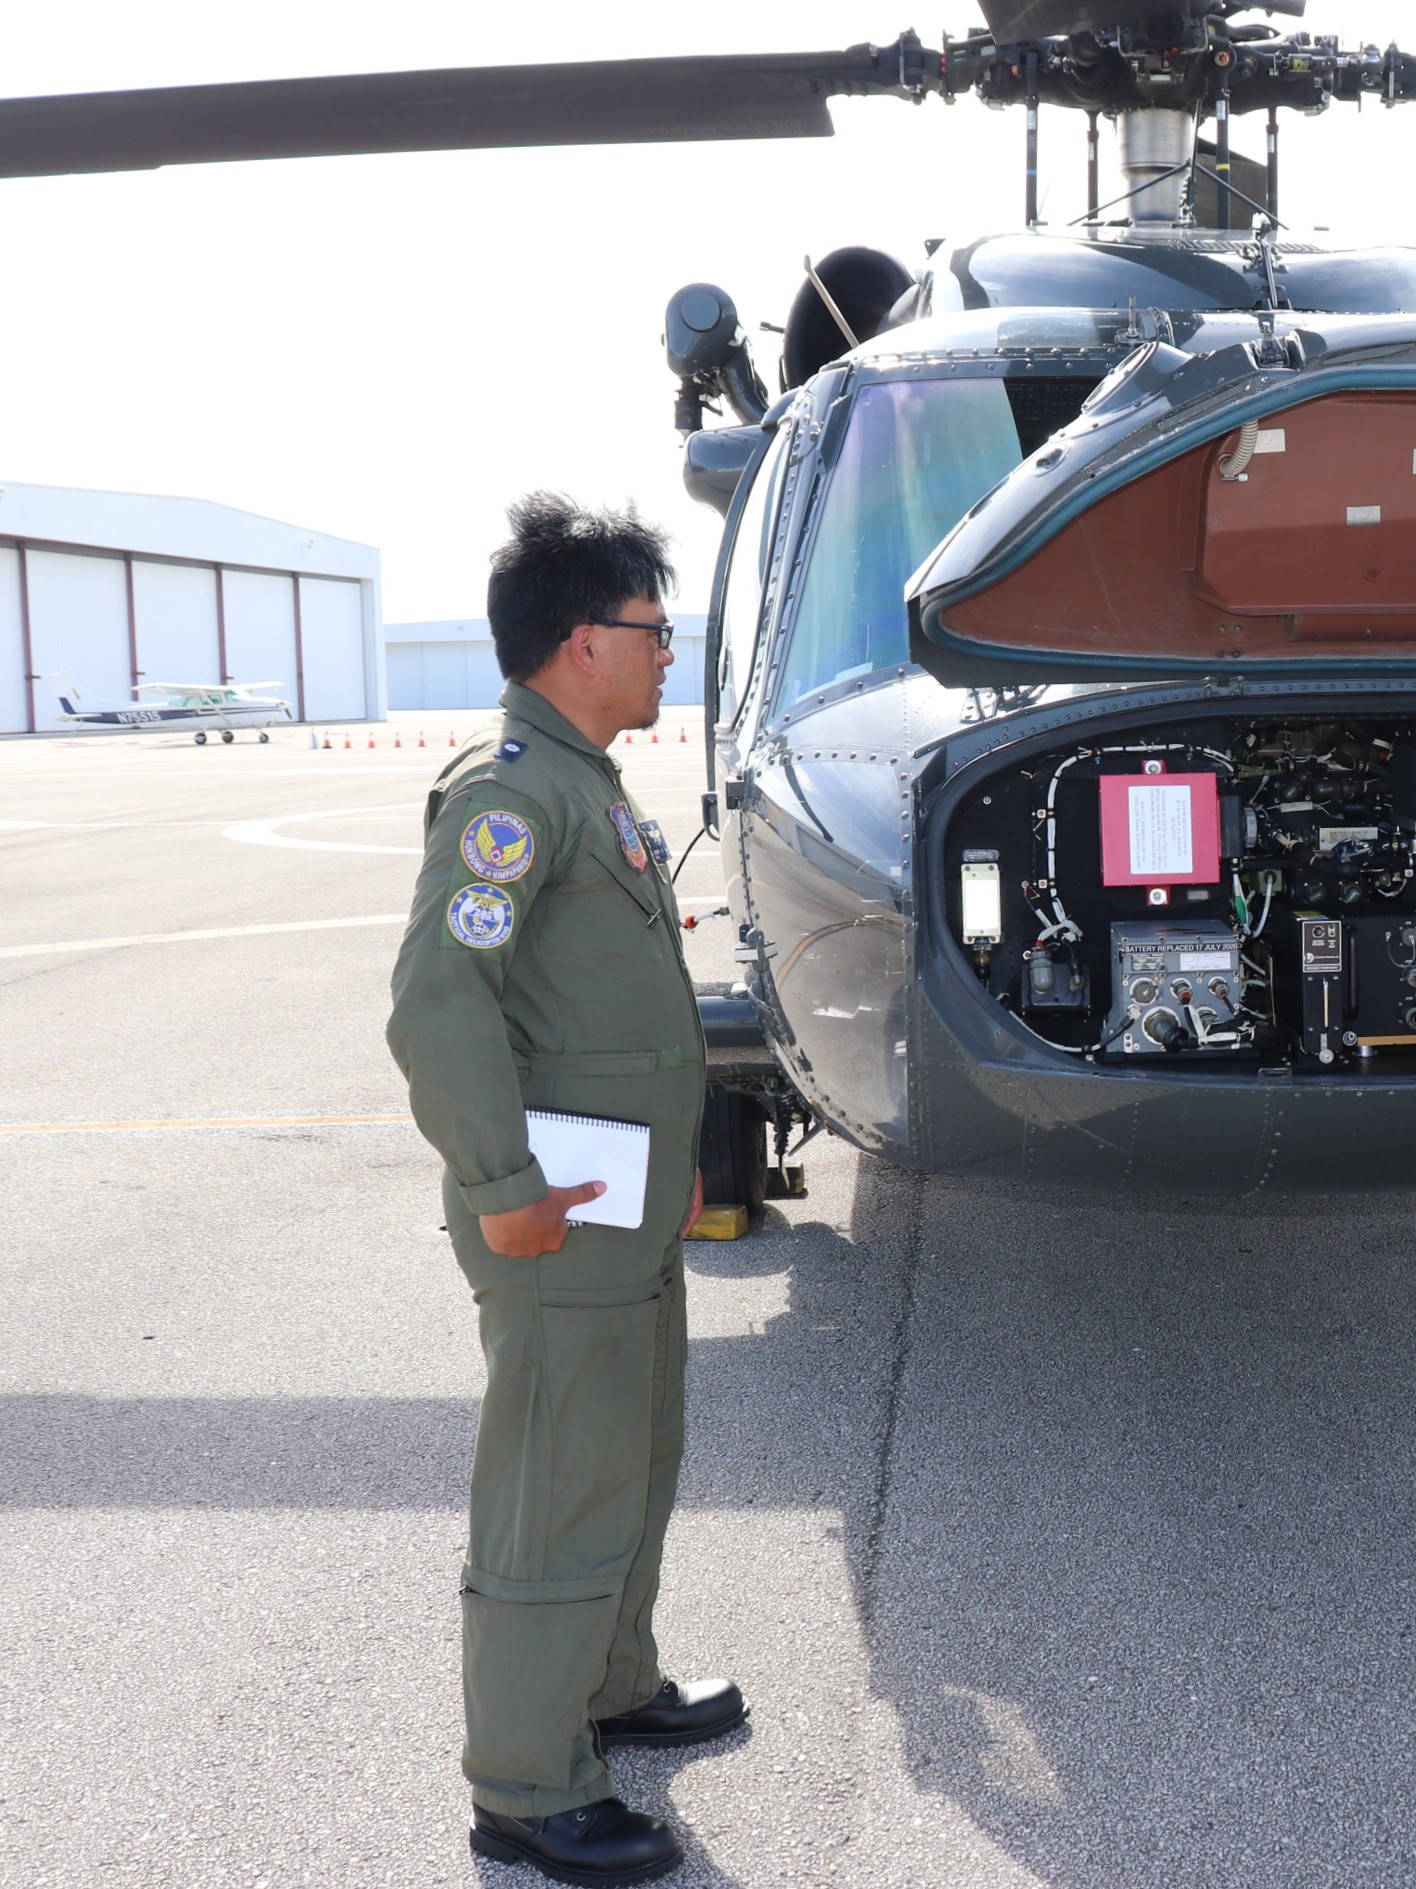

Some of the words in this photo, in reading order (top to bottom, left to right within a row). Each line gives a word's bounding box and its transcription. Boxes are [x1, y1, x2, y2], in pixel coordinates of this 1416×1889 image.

[116, 710, 161, 724] N75515
[489, 814, 526, 834] PILIPINAS
[465, 840, 486, 873] HUKBONG
